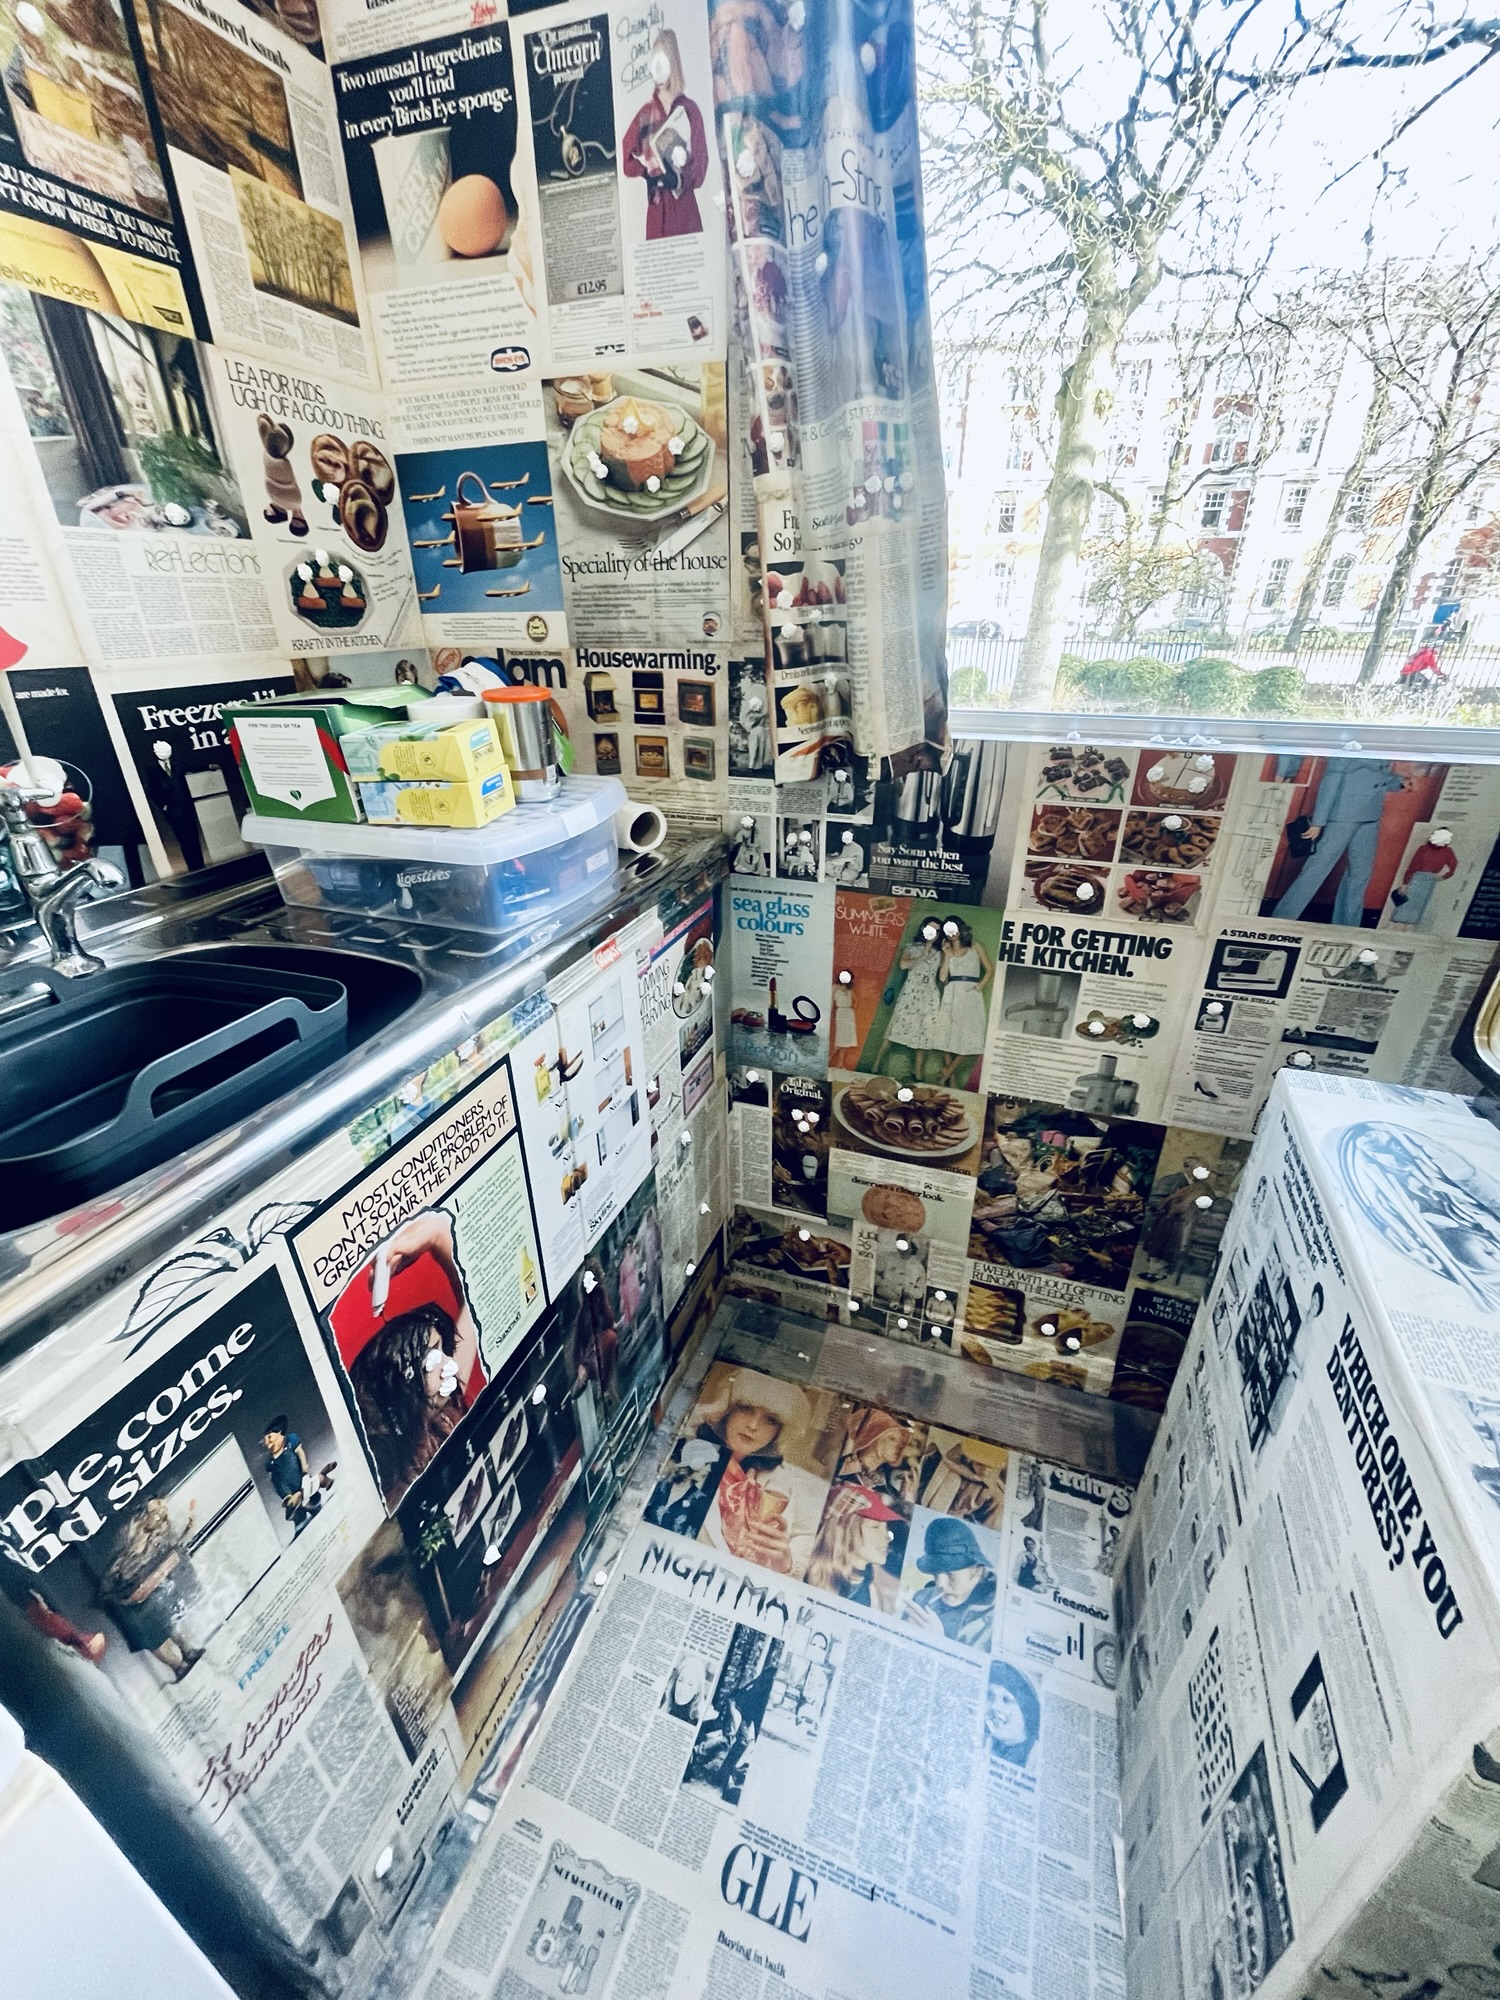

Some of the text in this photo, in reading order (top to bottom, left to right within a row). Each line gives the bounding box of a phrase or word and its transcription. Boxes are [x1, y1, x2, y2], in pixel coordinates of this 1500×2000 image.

[337, 36, 503, 93] Two unusual ingredients
[532, 36, 602, 75] Unicorn
[388, 68, 456, 106] you'll find
[344, 86, 513, 140] in every Birds Eye sponge.
[19, 188, 182, 264] KNOW WHERE TO FIND IT
[20, 172, 67, 203] KNOW
[66, 189, 109, 220] WHAT
[108, 203, 138, 231] YOU
[137, 216, 176, 248] WANT
[0, 265, 100, 304] ellow Pages
[259, 368, 293, 397] FOR
[230, 383, 268, 412] UGH
[269, 394, 289, 418] OF
[291, 400, 304, 422] A
[302, 402, 344, 430] GOOD
[562, 549, 728, 583] Speciality of the house
[575, 648, 721, 676] Housewarming.
[188, 726, 221, 751] in
[872, 855, 964, 873] you want the best
[899, 843, 926, 858] Sona
[929, 847, 960, 861] when
[732, 896, 811, 921] sea glass
[891, 885, 939, 899] SONA
[737, 914, 805, 937] colours
[1001, 920, 1173, 960] E FOR GETTING
[1219, 928, 1229, 937] A
[1229, 929, 1257, 939] STAR
[1257, 932, 1269, 940] IS
[998, 941, 1134, 978] HE KITCHEN.
[342, 1099, 485, 1230] MOST CONDITIONERS
[313, 1094, 508, 1278] DON'T SOLVE THE PROBLEM OF
[322, 1110, 509, 1288] GREASY HAIR. THEY ADD TO IT.
[980, 1264, 1126, 1306] WEEK WITHOUT GETTING
[1006, 1278, 1020, 1290] AT
[1018, 1282, 1048, 1298] THE
[1048, 1287, 1086, 1305] EDGES
[0, 1321, 257, 1546] ple, come
[106, 1383, 244, 1512] sizes.
[1326, 1343, 1406, 1573] DENTURES?
[1339, 1312, 1464, 1642] WHICH ONE YOU
[1052, 1589, 1110, 1622] freemans
[720, 1842, 819, 1945] GLE
[717, 1929, 786, 1979] Buying in bulk
